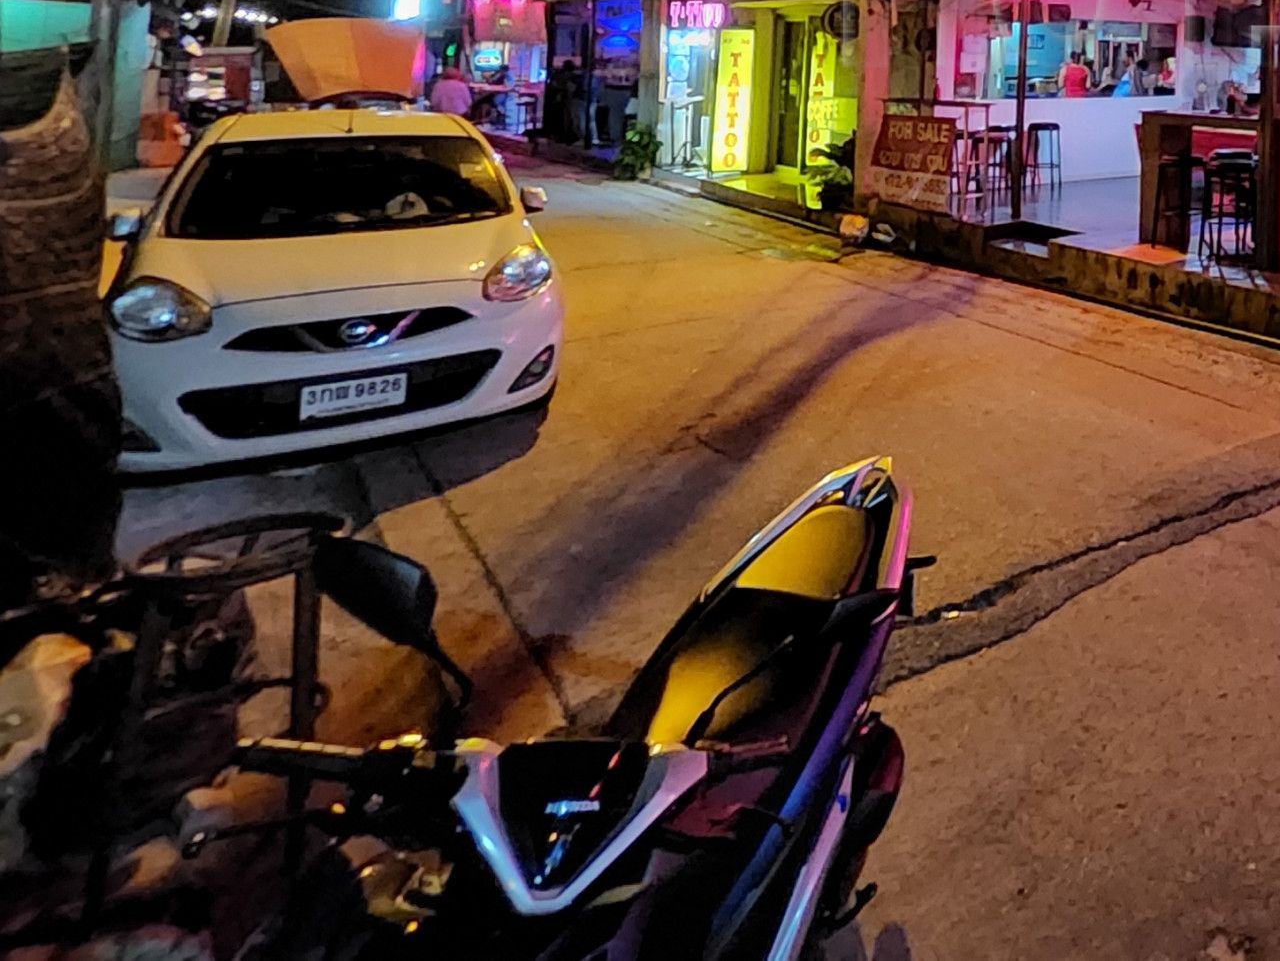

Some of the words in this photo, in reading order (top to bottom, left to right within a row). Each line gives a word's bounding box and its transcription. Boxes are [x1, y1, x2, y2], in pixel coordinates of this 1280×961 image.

[722, 51, 743, 168] TATTOO
[887, 120, 913, 141] FOR
[916, 122, 950, 144] SALE
[354, 377, 402, 398] 9826
